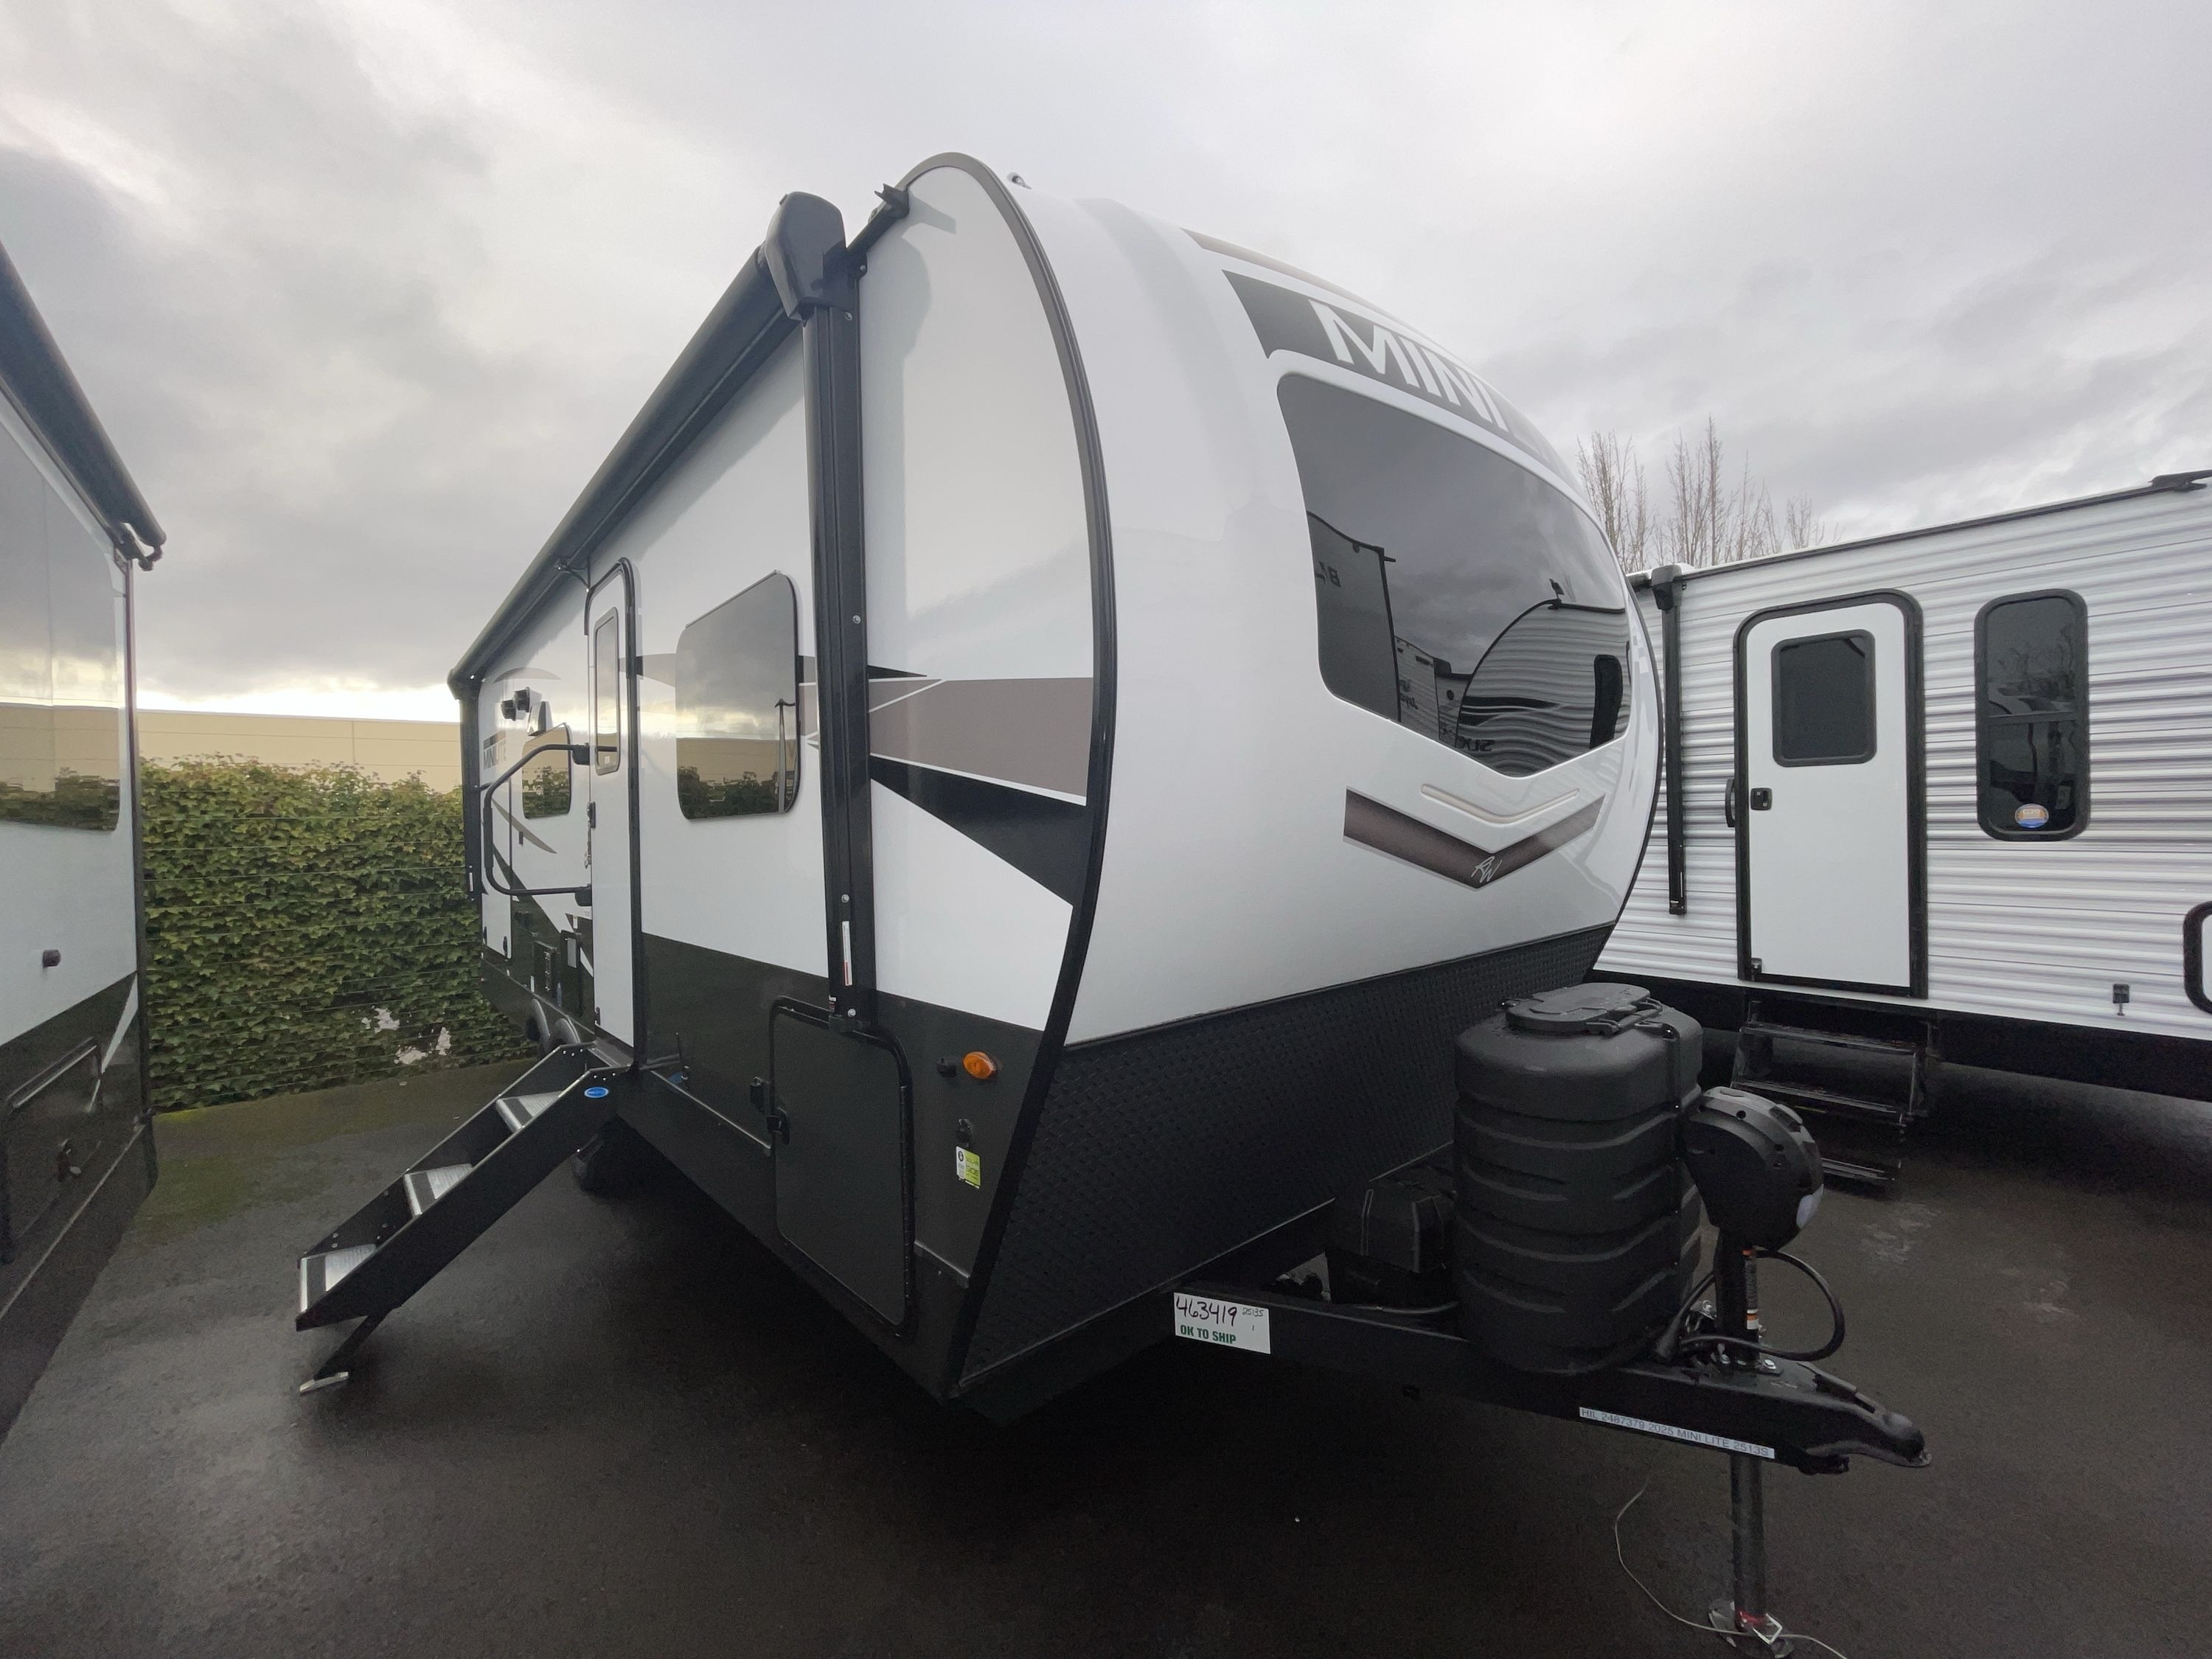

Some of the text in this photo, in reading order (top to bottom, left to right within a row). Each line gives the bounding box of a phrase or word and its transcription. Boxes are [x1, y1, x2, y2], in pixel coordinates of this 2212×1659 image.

[1309, 299, 1509, 432] MINI
[1175, 1295, 1238, 1326] 463419
[1180, 1324, 1237, 1344] OK TO SHIP
[1581, 1408, 1597, 1419] HIL
[1648, 1422, 1674, 1436] 2025
[1677, 1428, 1702, 1443] MINI
[1705, 1435, 1730, 1449] LITE
[1733, 1441, 1769, 1456] 2513S
